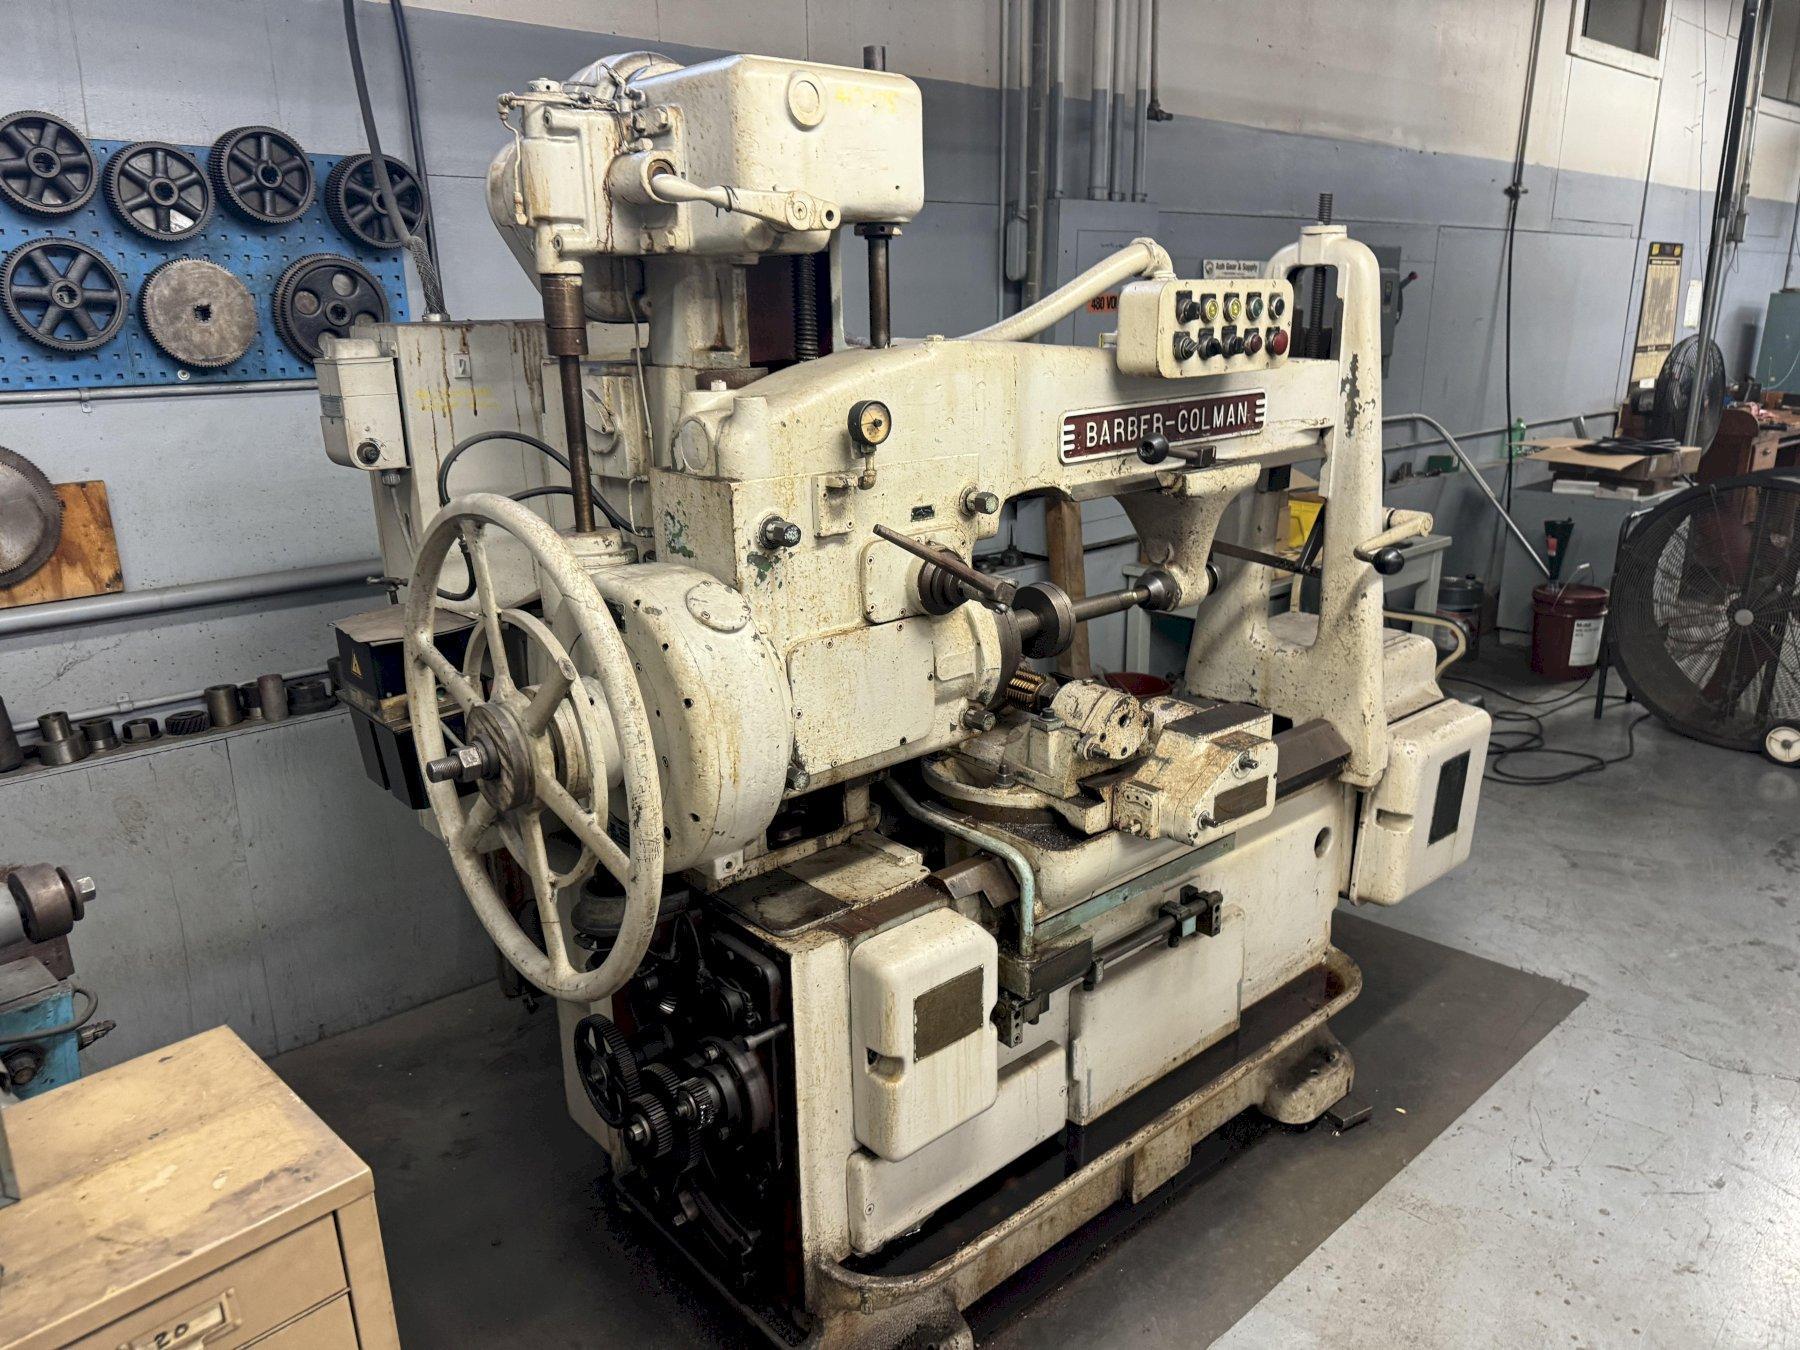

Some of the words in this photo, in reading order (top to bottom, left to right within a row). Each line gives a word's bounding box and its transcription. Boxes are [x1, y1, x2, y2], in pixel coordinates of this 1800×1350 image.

[1242, 262, 1258, 273] Supply
[1091, 296, 1105, 310] 480
[1086, 401, 1248, 448] BARBER-COLMAN
[154, 1322, 188, 1349] 20
